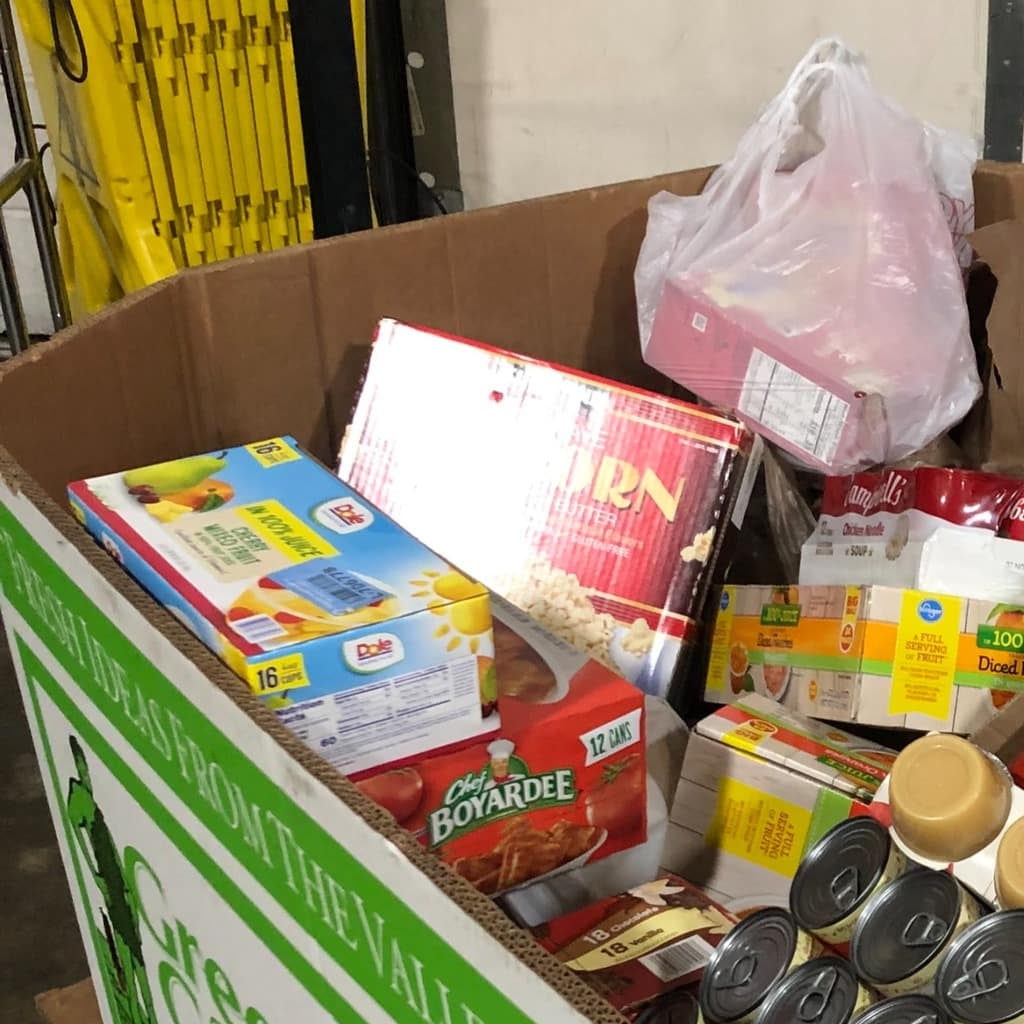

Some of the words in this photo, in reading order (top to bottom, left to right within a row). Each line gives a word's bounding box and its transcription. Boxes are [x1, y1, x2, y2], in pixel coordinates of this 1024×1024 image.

[328, 502, 365, 527] Dole
[356, 639, 393, 658] Dole
[904, 640, 948, 655] SERVING
[920, 632, 945, 645] FULL
[916, 652, 945, 665] FRUIT
[978, 655, 1018, 676] Diced
[257, 666, 278, 691] 16
[589, 736, 606, 758] 12
[608, 720, 634, 749] CANS
[445, 771, 488, 805] Chef
[430, 768, 576, 846] BOYARDEE
[266, 811, 358, 952] THE
[584, 929, 611, 945] 18
[600, 942, 629, 957] 18
